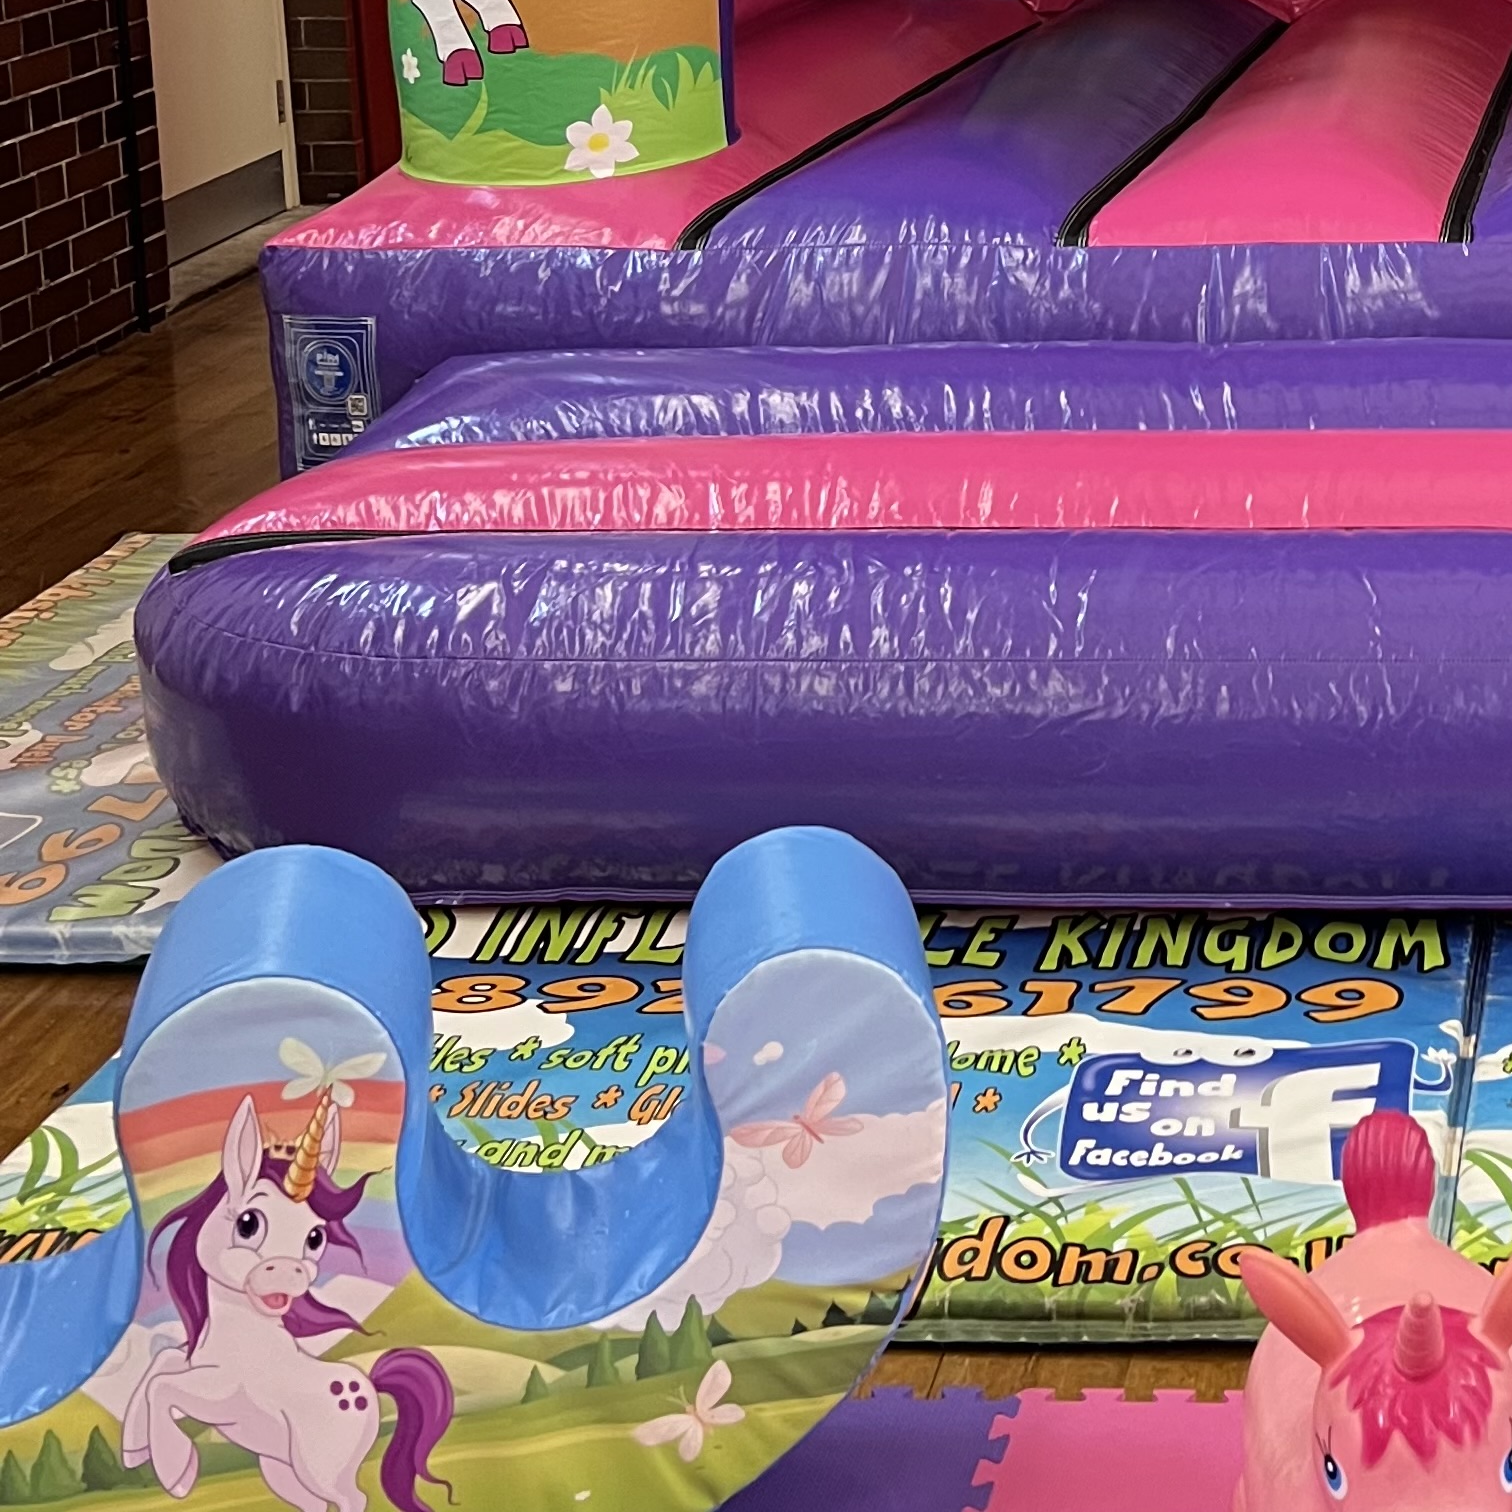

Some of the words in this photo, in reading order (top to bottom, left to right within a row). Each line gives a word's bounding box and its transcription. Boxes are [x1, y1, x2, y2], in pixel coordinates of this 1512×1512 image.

[1037, 911, 1450, 973] KINGDOM
[540, 1033, 645, 1071] soft
[447, 1078, 578, 1121] Slides
[1104, 1069, 1236, 1097] Find
[1082, 1102, 1151, 1122] us
[1150, 1117, 1215, 1136] on
[474, 1128, 583, 1170] and
[1068, 1139, 1243, 1167] Facebook
